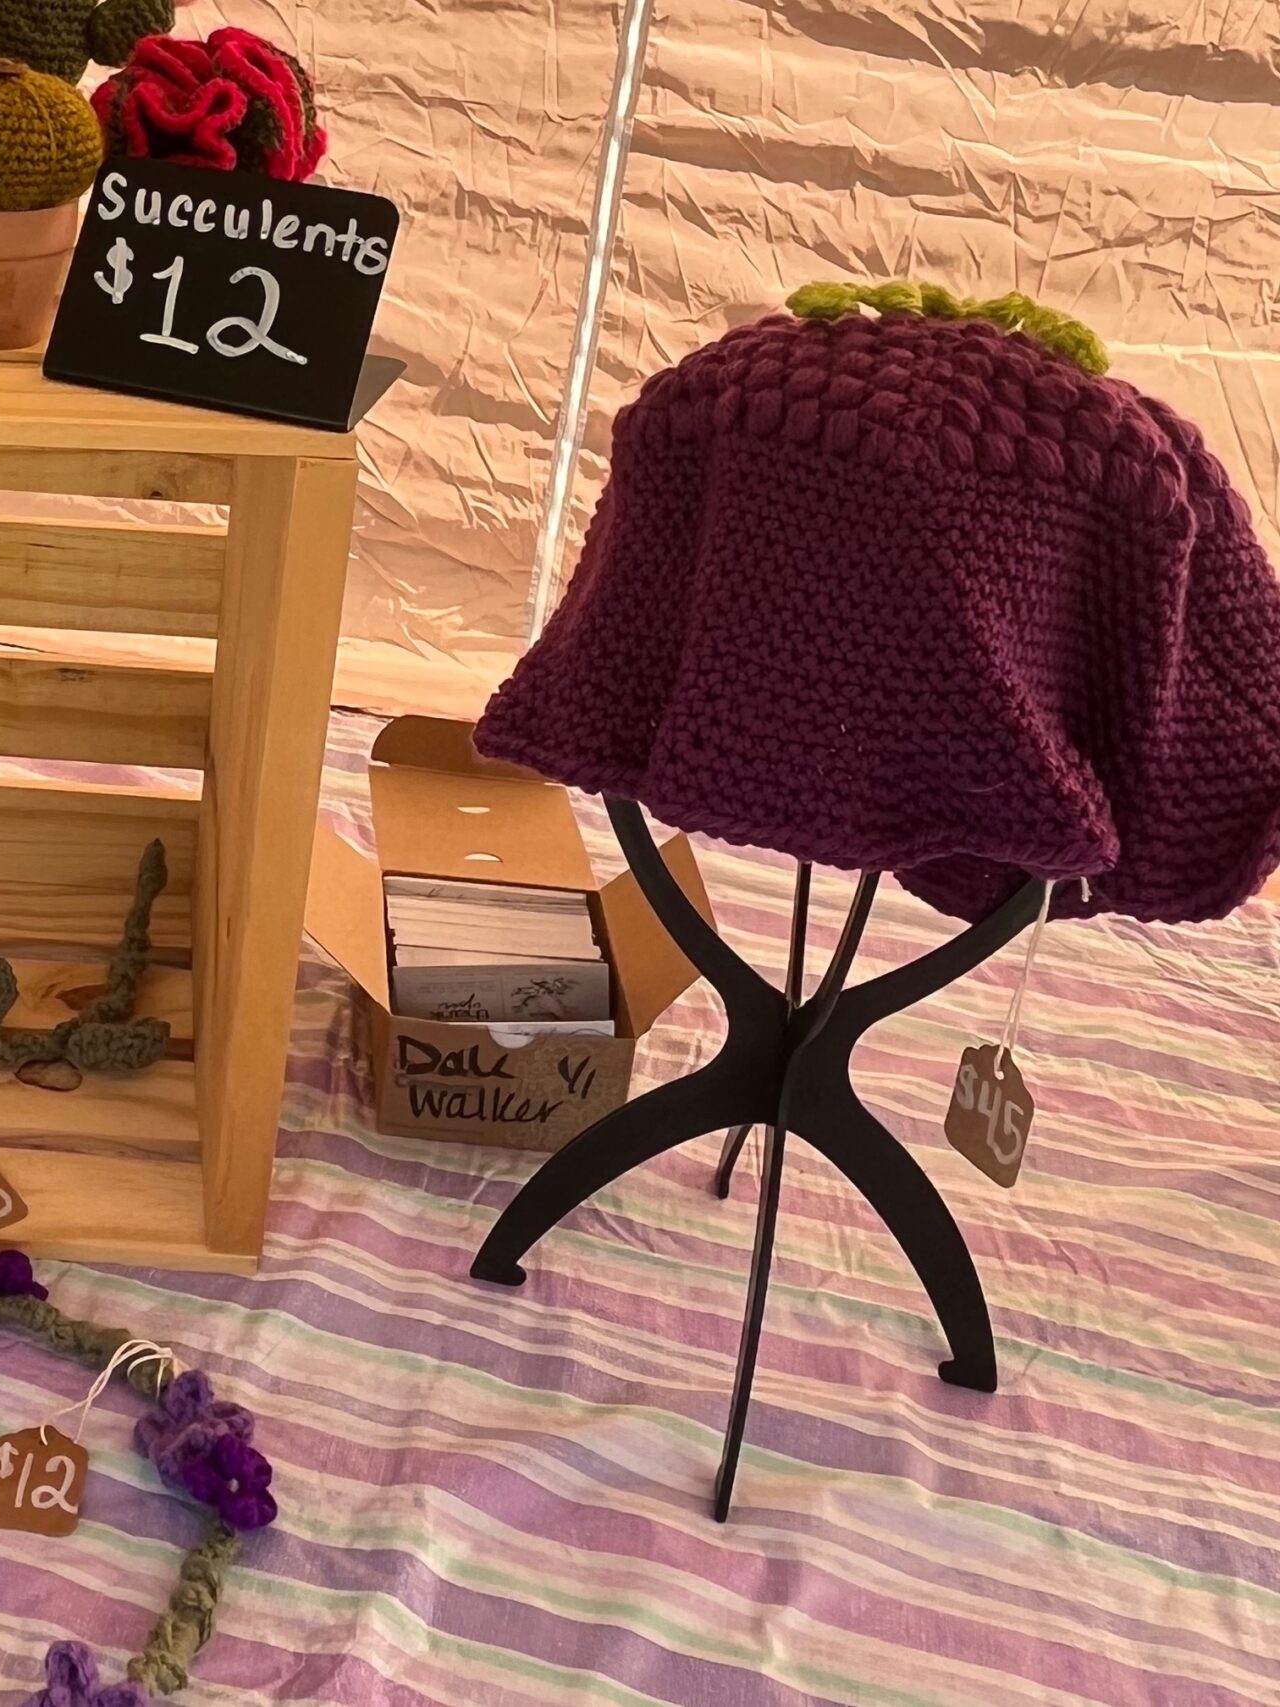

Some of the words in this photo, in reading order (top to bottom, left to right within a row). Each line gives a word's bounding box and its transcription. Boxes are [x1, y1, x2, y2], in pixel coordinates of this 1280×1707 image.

[97, 171, 388, 276] Succulents
[408, 1085, 565, 1124] Walker
[955, 1063, 1025, 1166] $45
